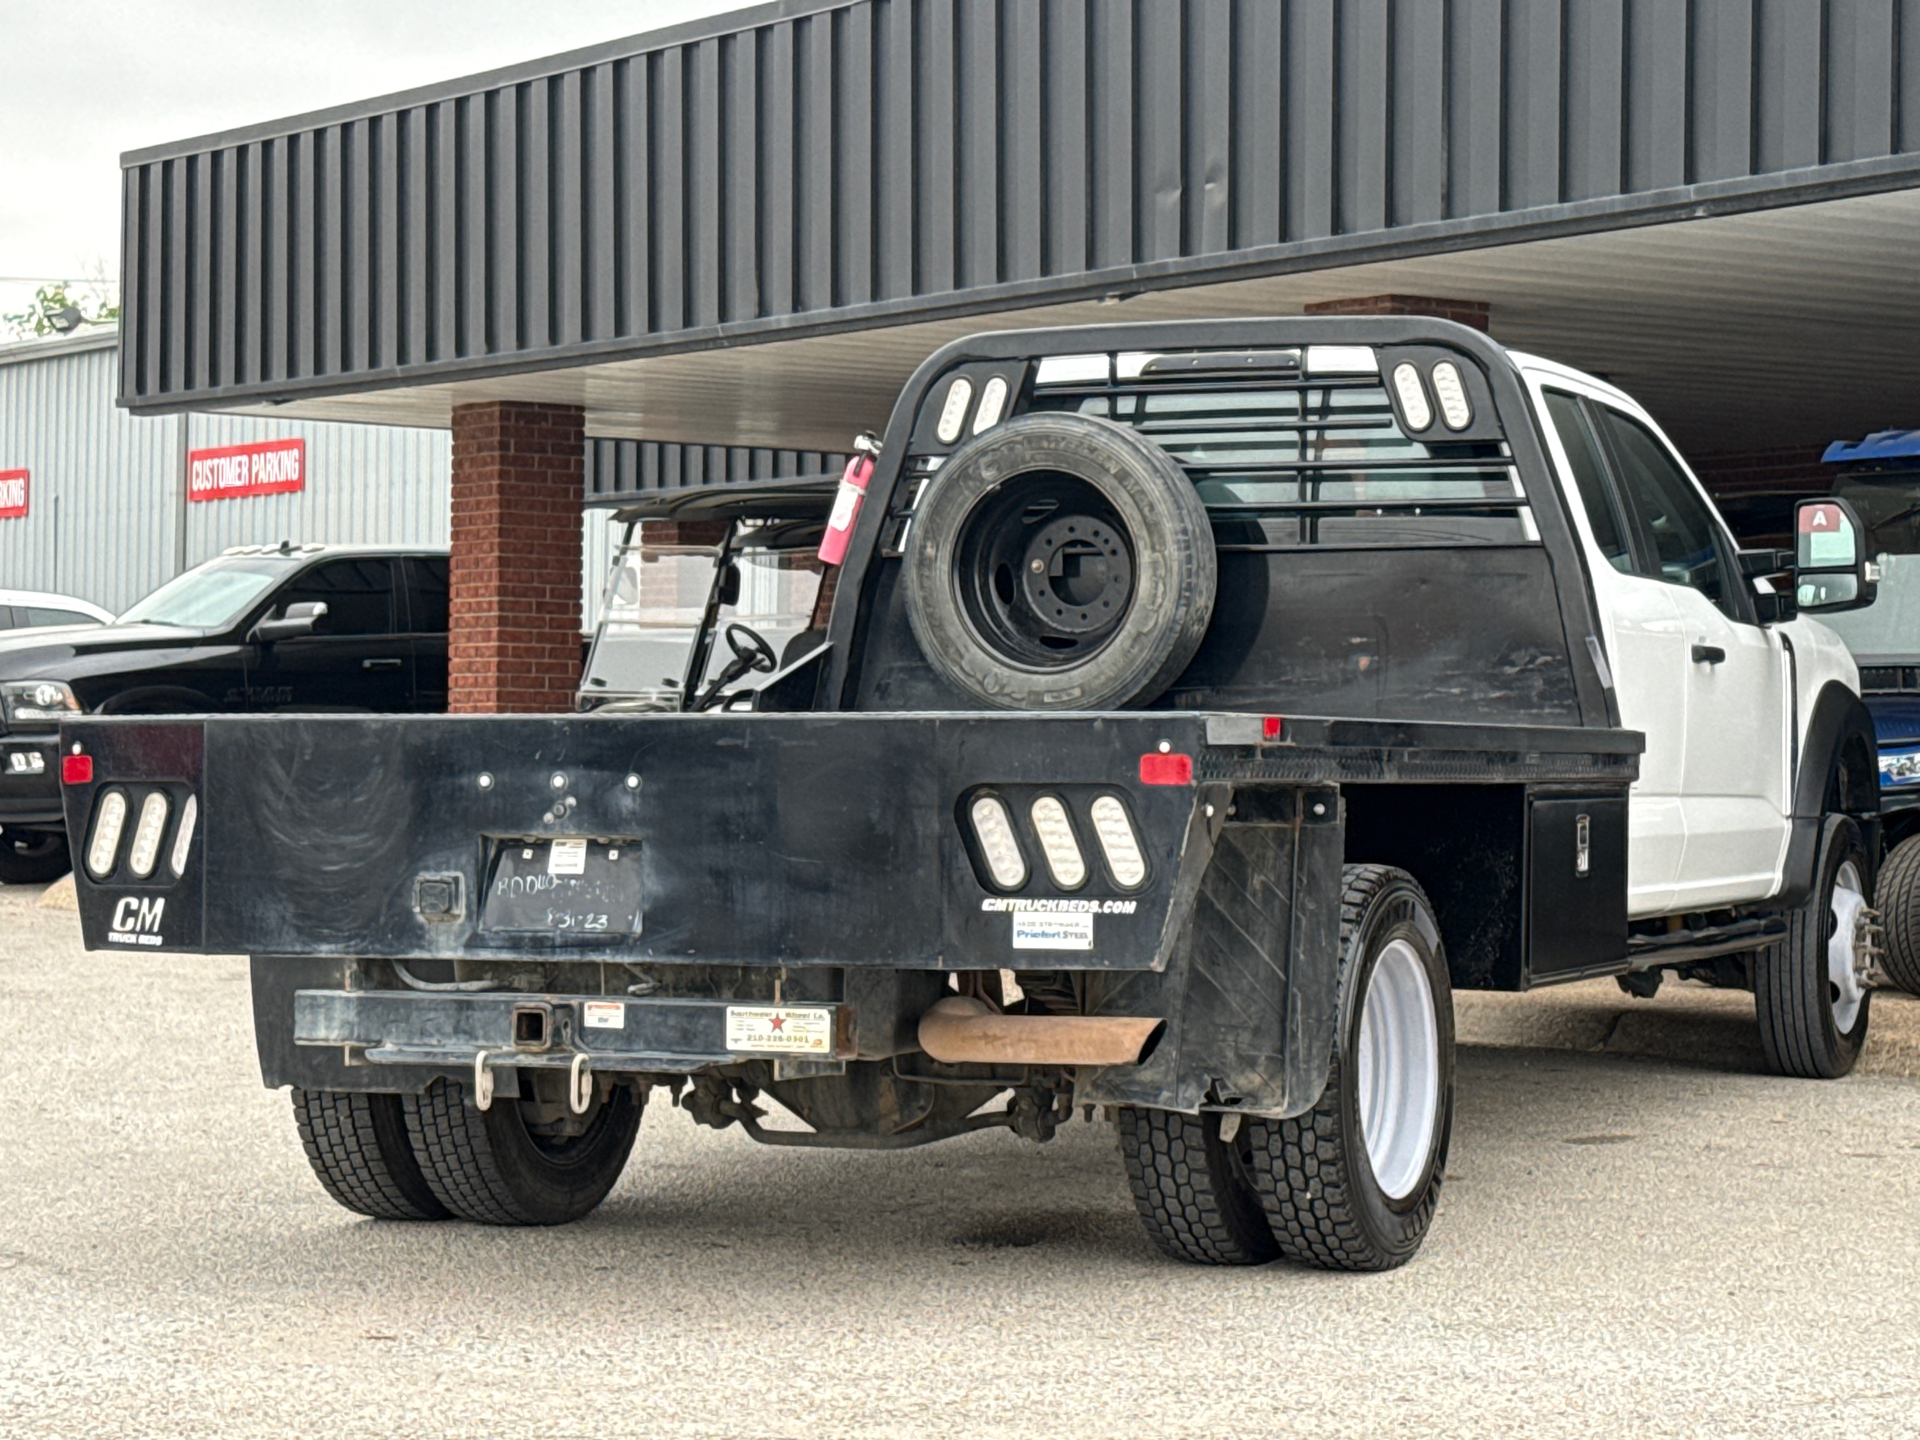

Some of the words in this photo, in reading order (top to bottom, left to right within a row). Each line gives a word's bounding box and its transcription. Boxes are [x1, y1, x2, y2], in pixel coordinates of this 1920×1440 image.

[192, 455, 249, 491] CUSTOMER
[251, 448, 300, 485] PARKING
[112, 896, 165, 932] CM
[981, 898, 1137, 914] CMTRUCKBEDS.COM
